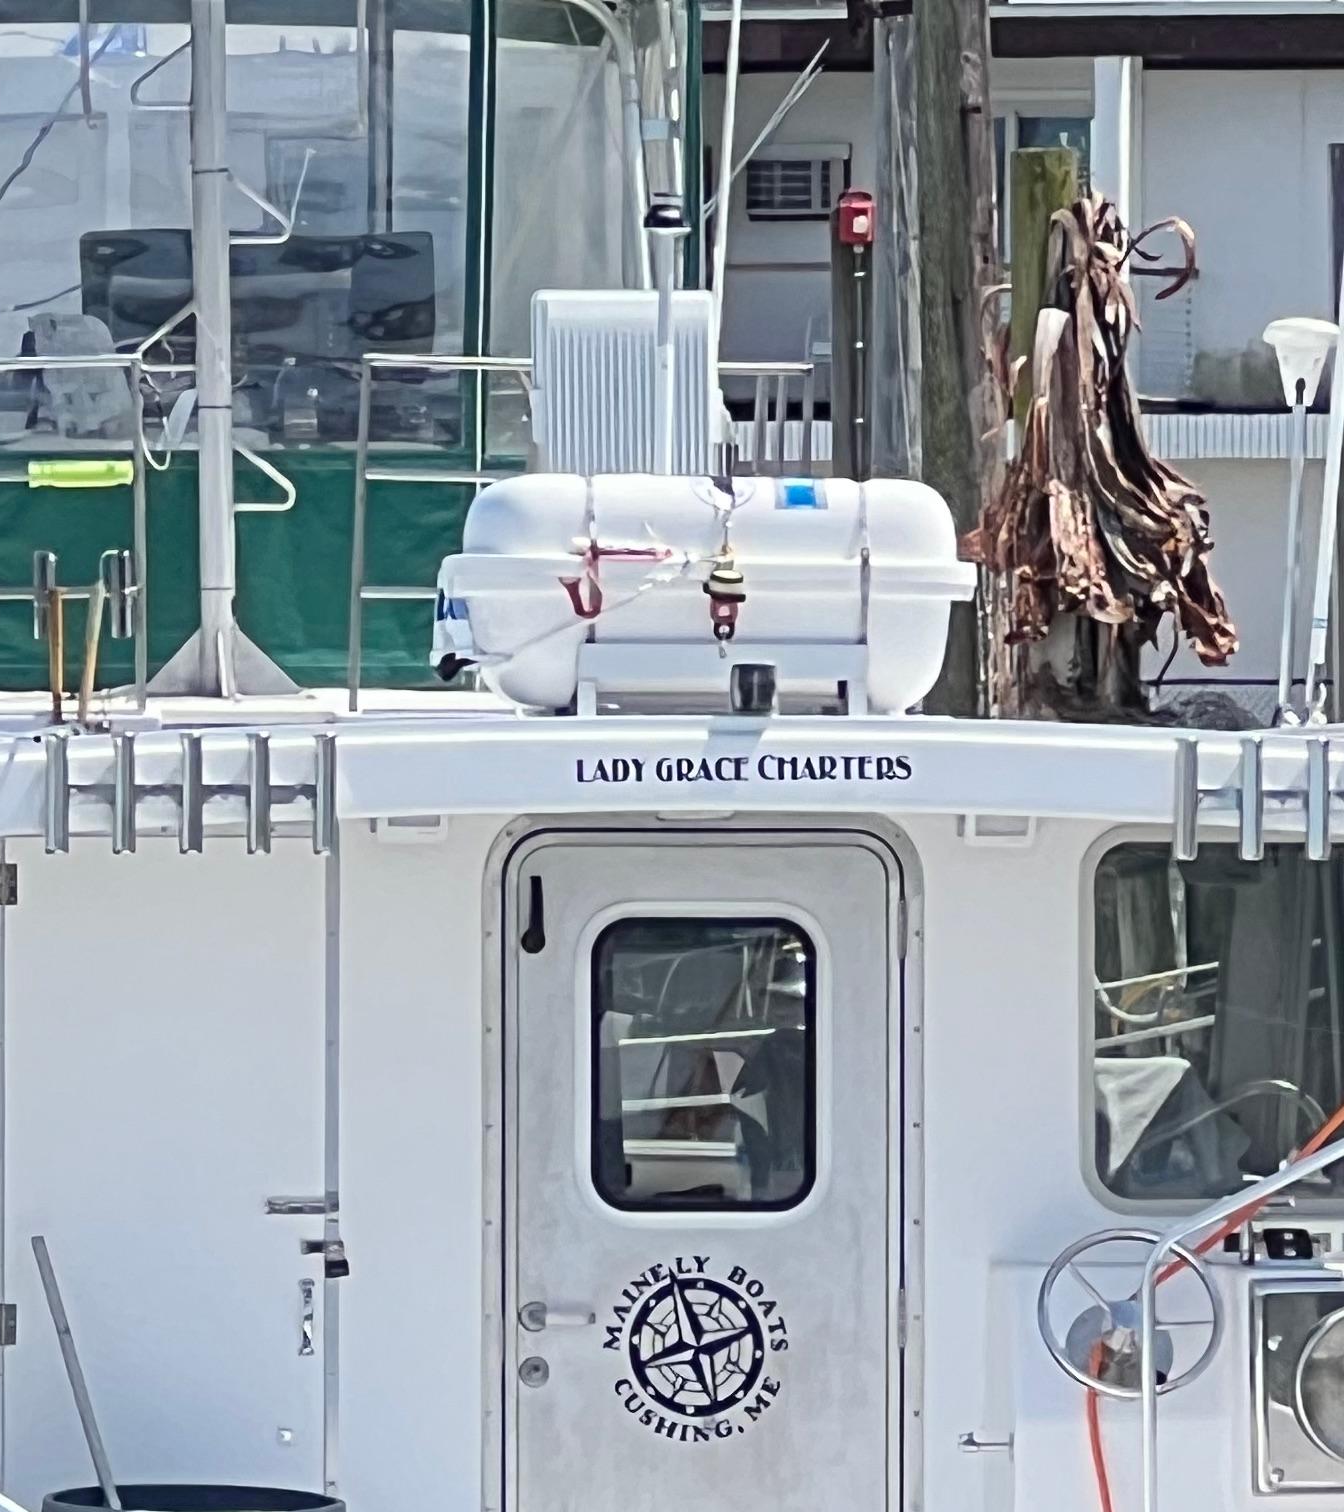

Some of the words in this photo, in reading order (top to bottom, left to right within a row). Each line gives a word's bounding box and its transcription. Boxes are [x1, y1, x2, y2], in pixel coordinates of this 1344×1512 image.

[576, 757, 645, 783] LADY
[655, 757, 750, 783] GRACE
[757, 754, 913, 781] CHARTERS
[602, 1255, 711, 1351] MAINELY
[726, 1265, 790, 1353] BOATS
[743, 1375, 781, 1422] ME
